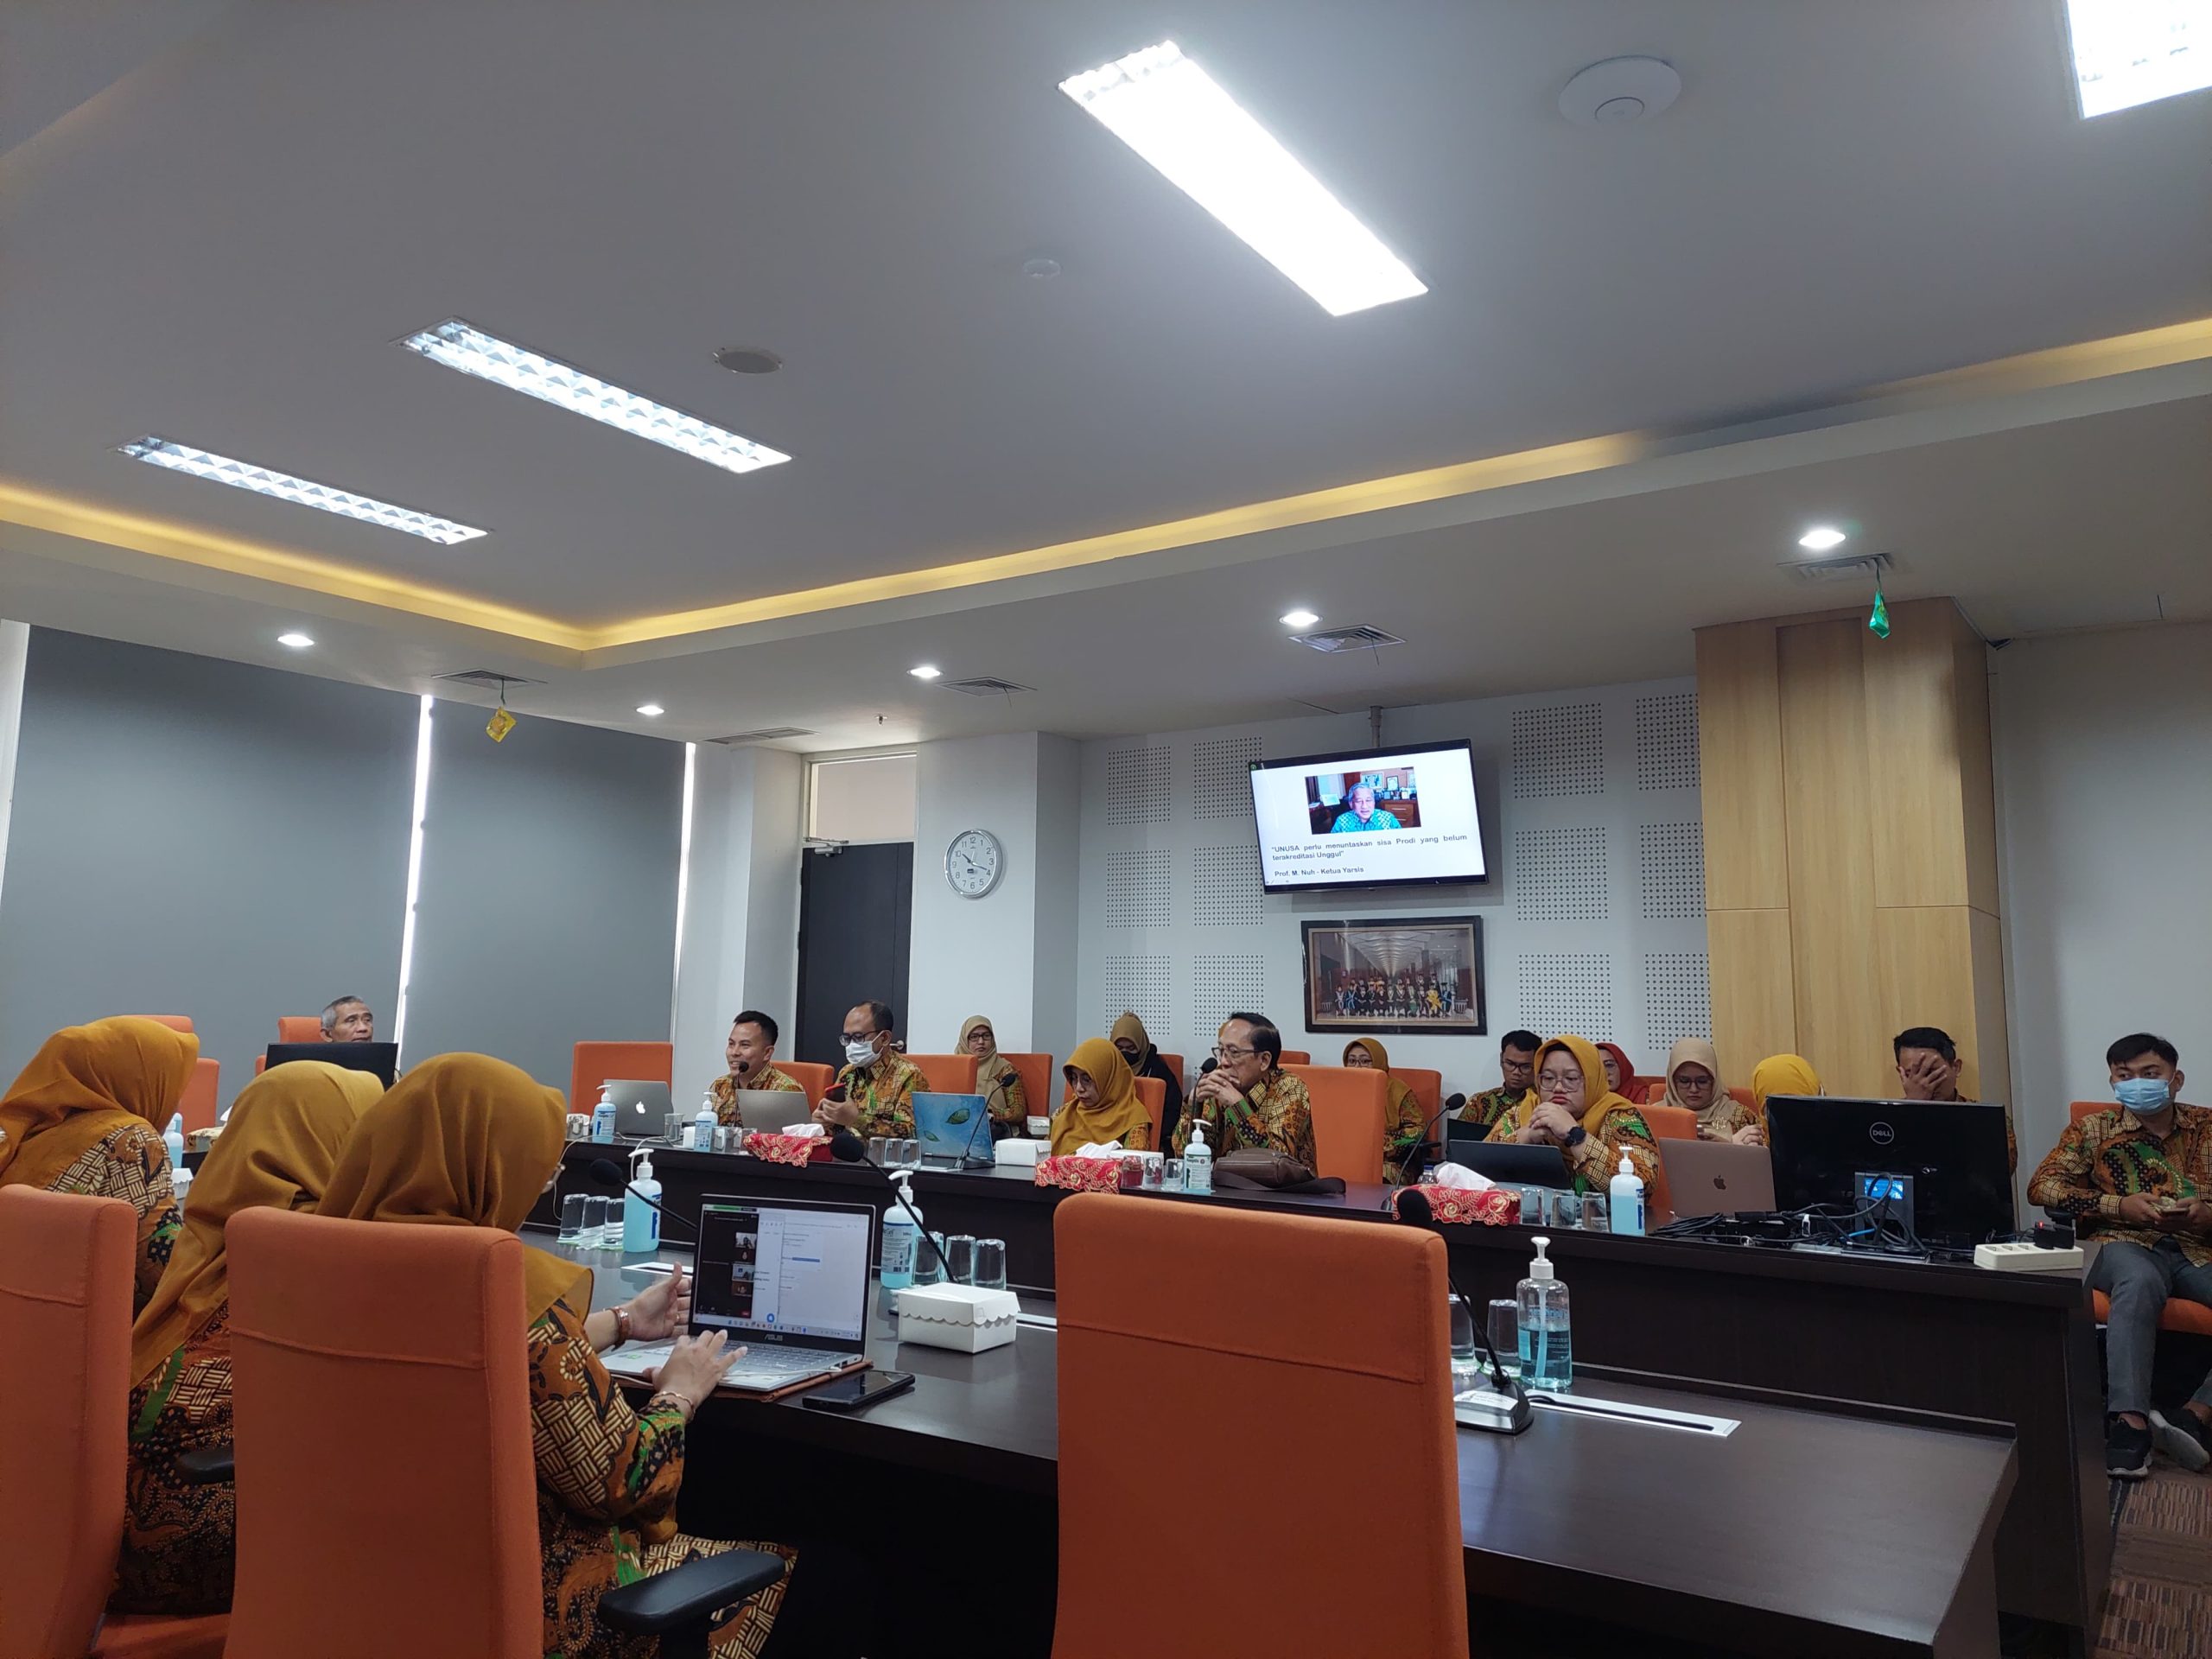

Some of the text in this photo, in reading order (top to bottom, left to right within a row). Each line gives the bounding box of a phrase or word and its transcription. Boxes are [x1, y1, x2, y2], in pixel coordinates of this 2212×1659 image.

[1303, 844, 1322, 852] perlu
[1325, 841, 1373, 849] menuntaskan
[1420, 836, 1439, 844] yang
